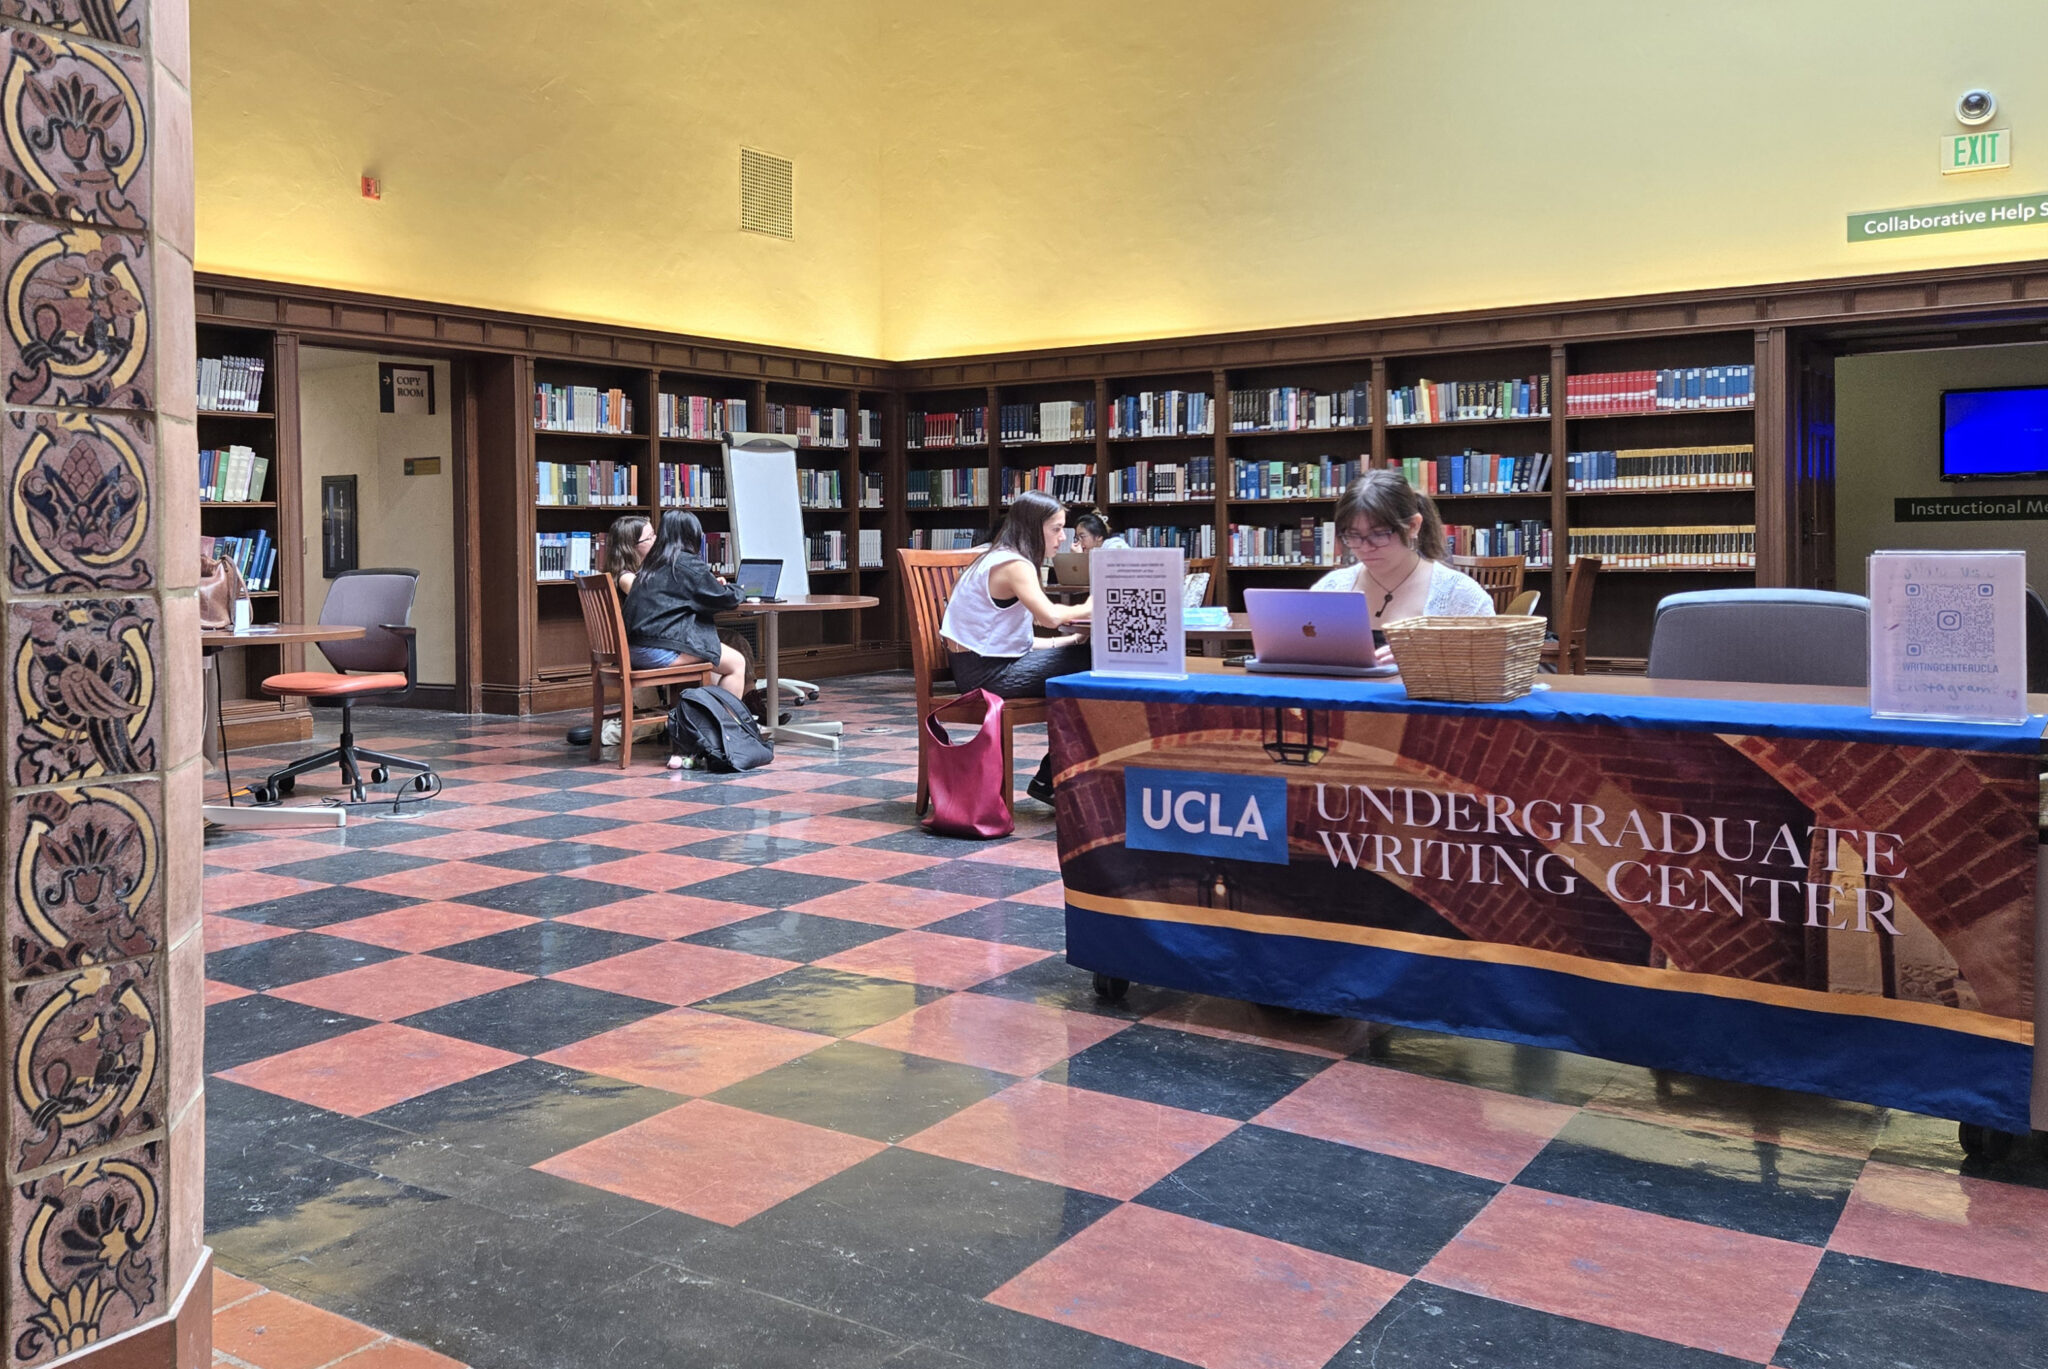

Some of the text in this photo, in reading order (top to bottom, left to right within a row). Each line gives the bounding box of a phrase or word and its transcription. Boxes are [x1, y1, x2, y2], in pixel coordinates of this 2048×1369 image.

[1953, 133, 1999, 167] EXIT
[1864, 211, 1986, 234] Collaborative
[1991, 203, 2035, 222] Help
[396, 376, 420, 386] COPY
[397, 387, 424, 398] ROOM
[1911, 500, 2021, 516] Instructional
[1902, 662, 1999, 674] WRITINGCENTERUCLA
[1142, 788, 1269, 841] UCLA
[1315, 783, 1908, 879] UNDERGRADUATE
[1317, 830, 1905, 936] WRITING CENTER
